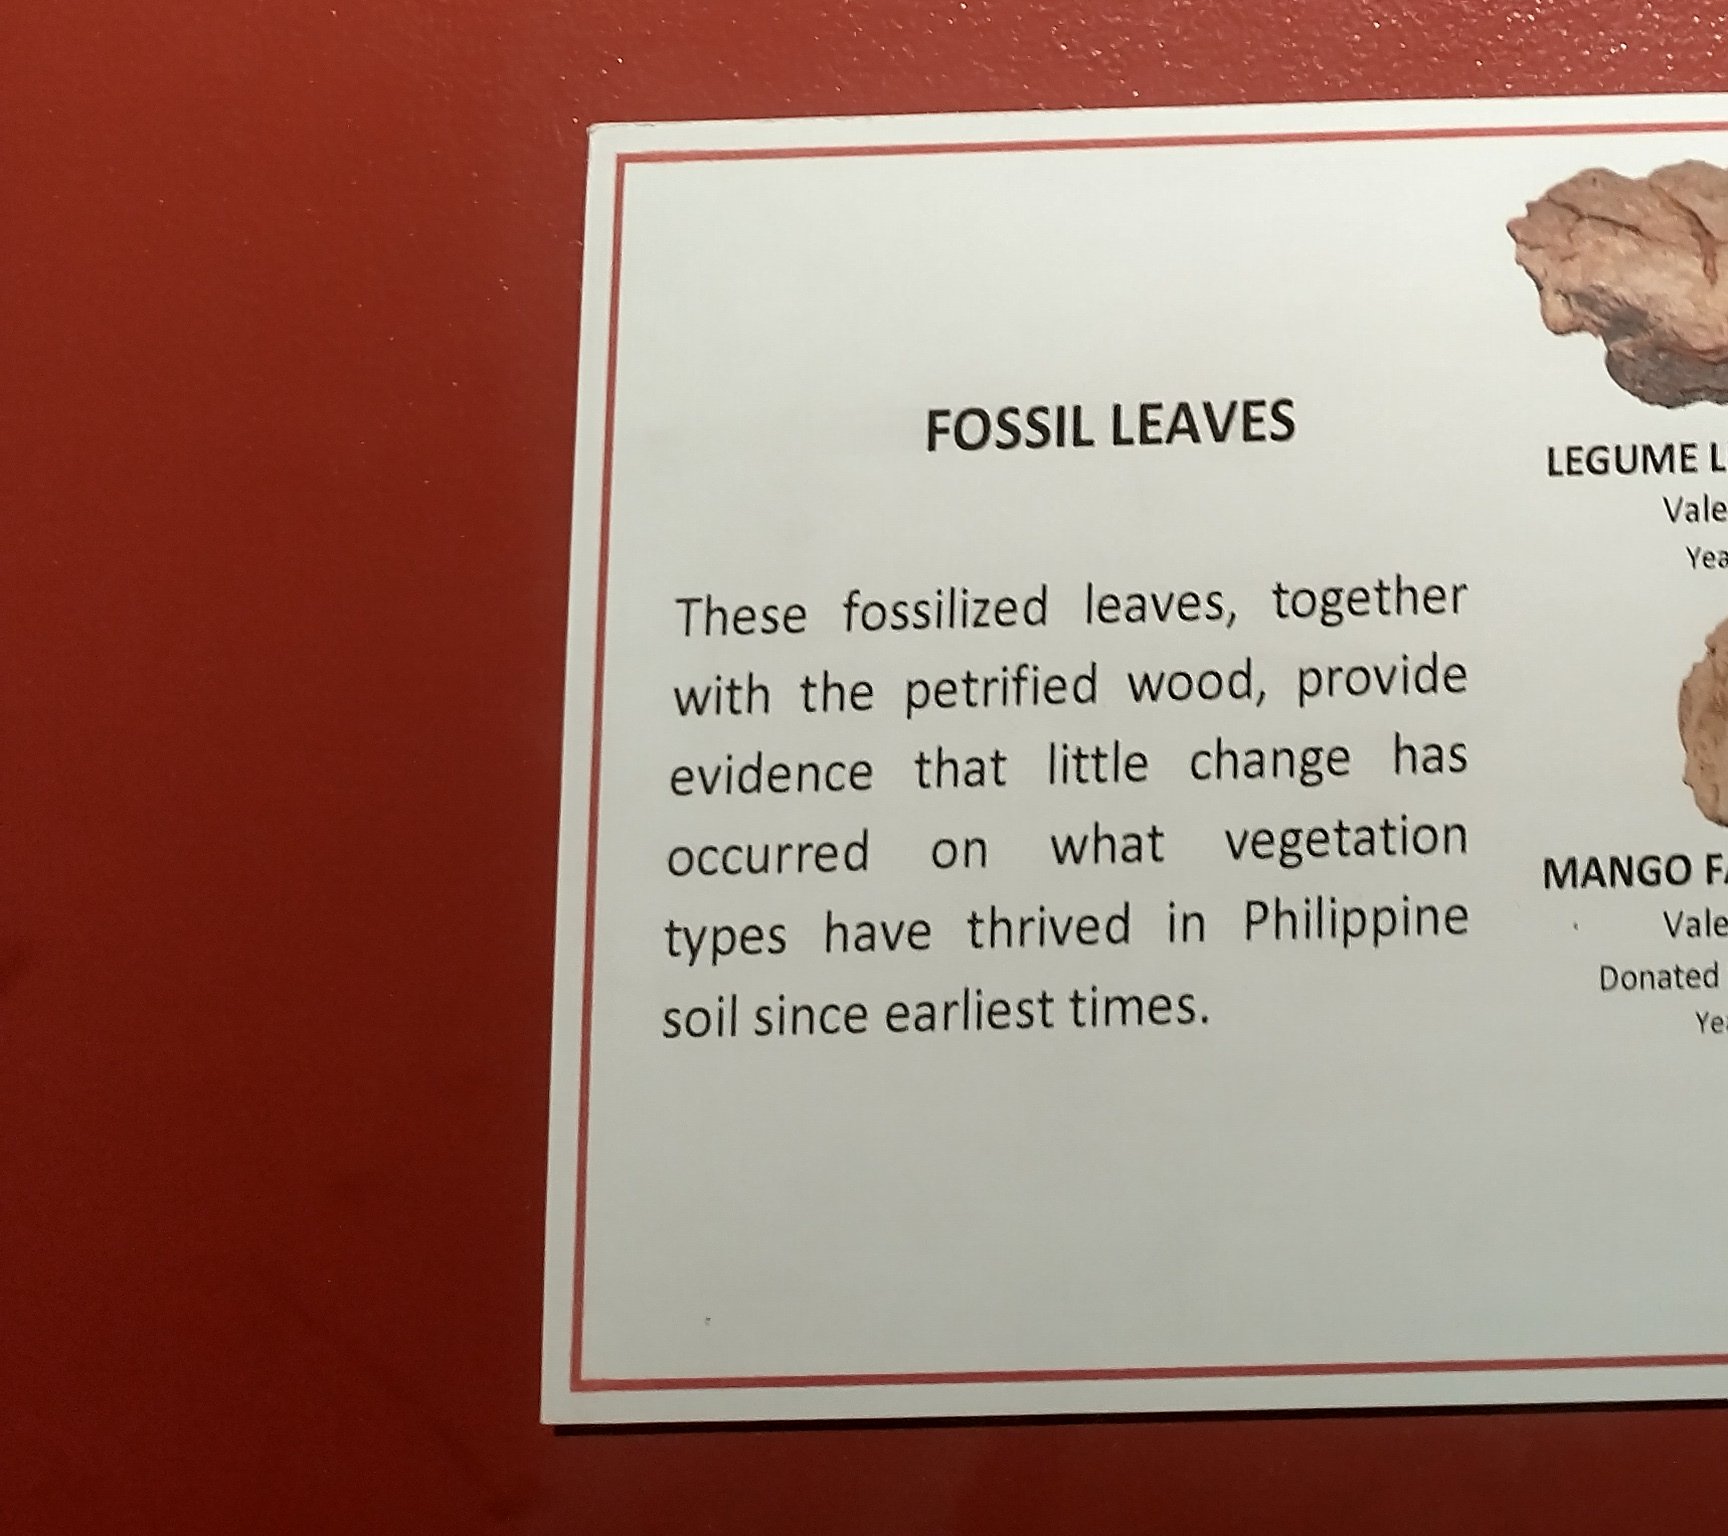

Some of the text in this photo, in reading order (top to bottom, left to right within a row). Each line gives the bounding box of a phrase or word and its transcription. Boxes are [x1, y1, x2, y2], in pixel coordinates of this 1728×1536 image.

[927, 398, 1295, 452] FOSSIL LEAVES
[1548, 442, 1698, 477] LEGUME
[675, 573, 1468, 637] These fossilized leaves, together
[673, 651, 1467, 721] with the petrified wood, provide
[670, 731, 1467, 797] evidence that little change has
[668, 813, 1467, 877] occurred on what vegetation
[1543, 854, 1692, 890] MANGO
[664, 894, 1468, 967] types have thrived in Philippine
[1600, 960, 1719, 992] Donated
[662, 985, 1209, 1039] soil since earliest times.
